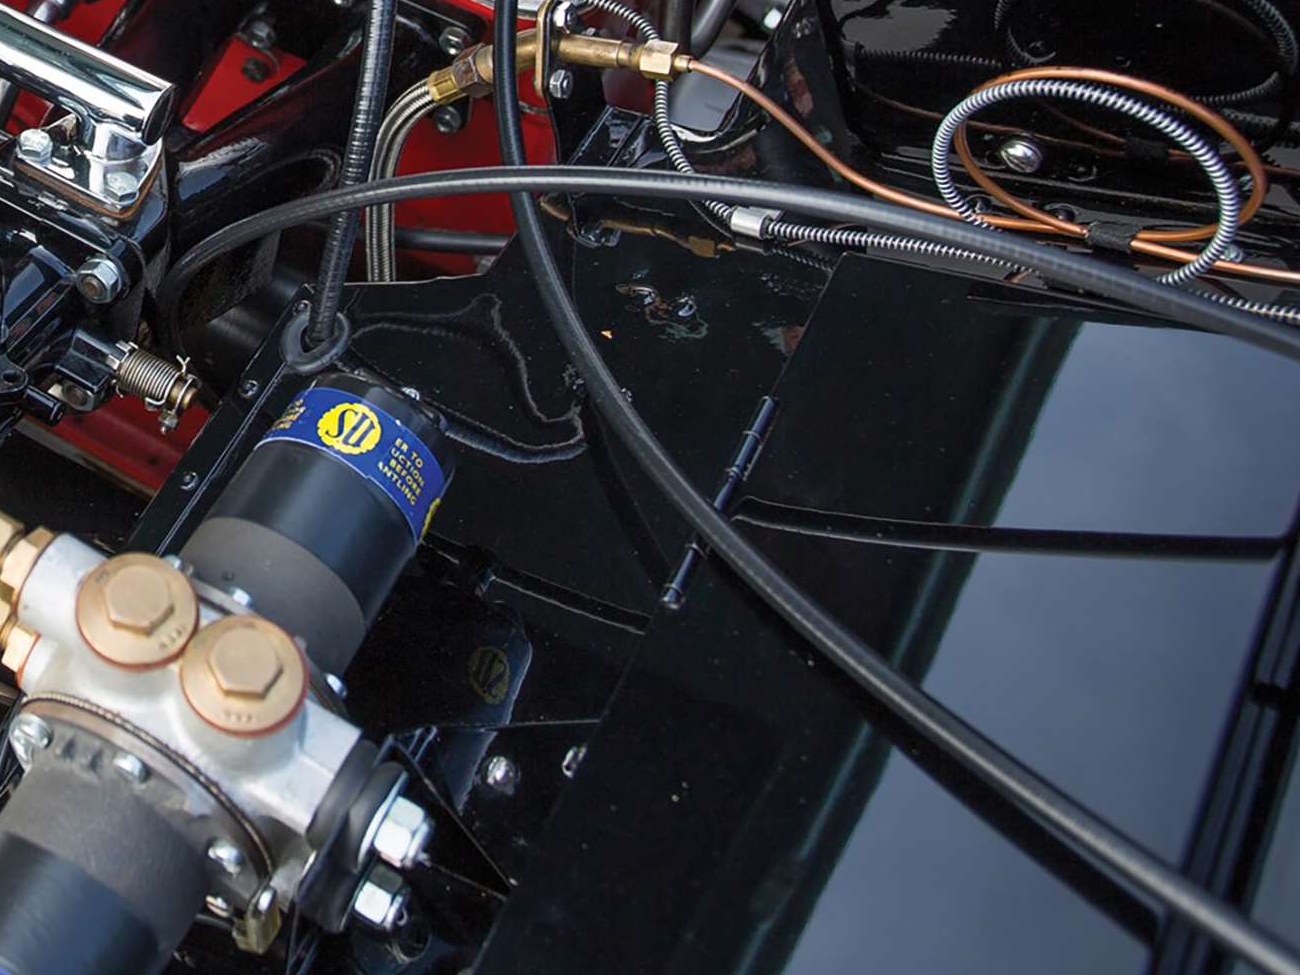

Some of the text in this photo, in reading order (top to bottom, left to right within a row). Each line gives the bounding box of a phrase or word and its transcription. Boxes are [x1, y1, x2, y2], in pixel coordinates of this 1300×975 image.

[325, 408, 375, 447] SU
[389, 458, 421, 495] BEFORE
[411, 451, 423, 468] TO
